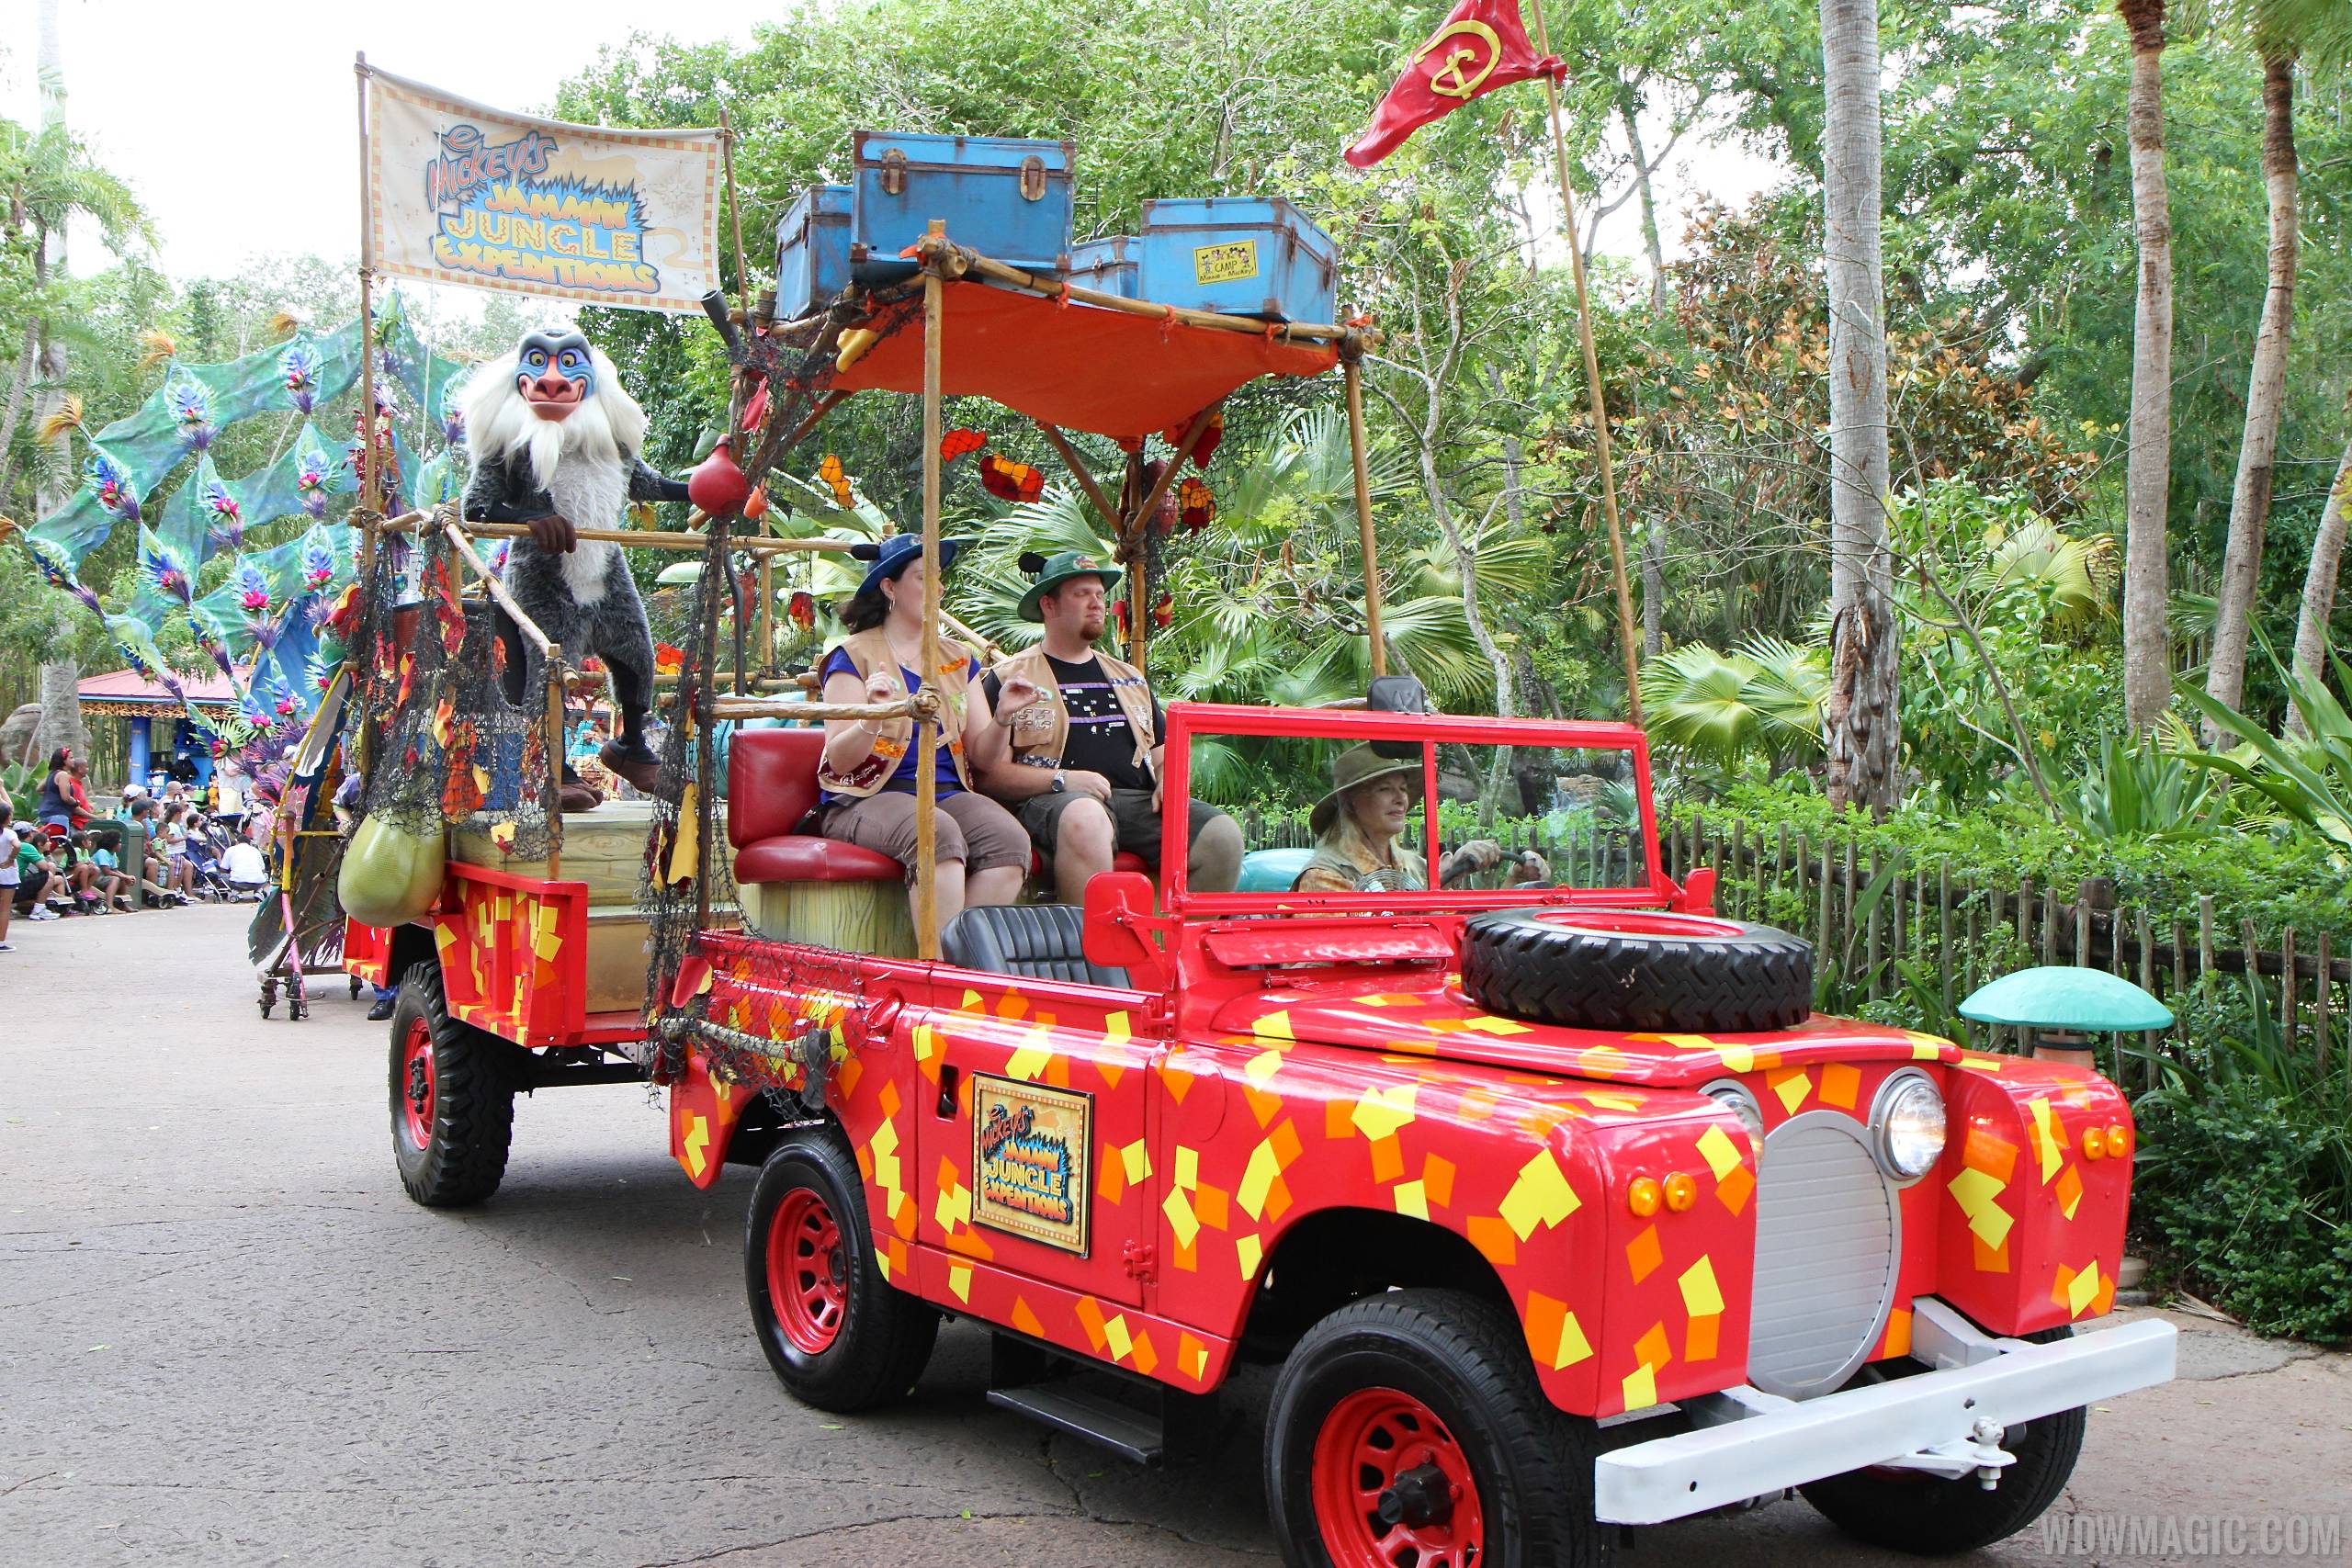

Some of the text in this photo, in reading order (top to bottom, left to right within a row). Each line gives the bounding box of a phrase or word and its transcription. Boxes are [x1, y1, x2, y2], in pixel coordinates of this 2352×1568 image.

[445, 209, 639, 262] JUNGLE
[434, 235, 661, 293] EXPEDITIONS
[1215, 260, 1238, 273] CAMP
[983, 1177, 1069, 1222] EXPEDITIONS
[986, 1157, 1063, 1197] JUNGLE
